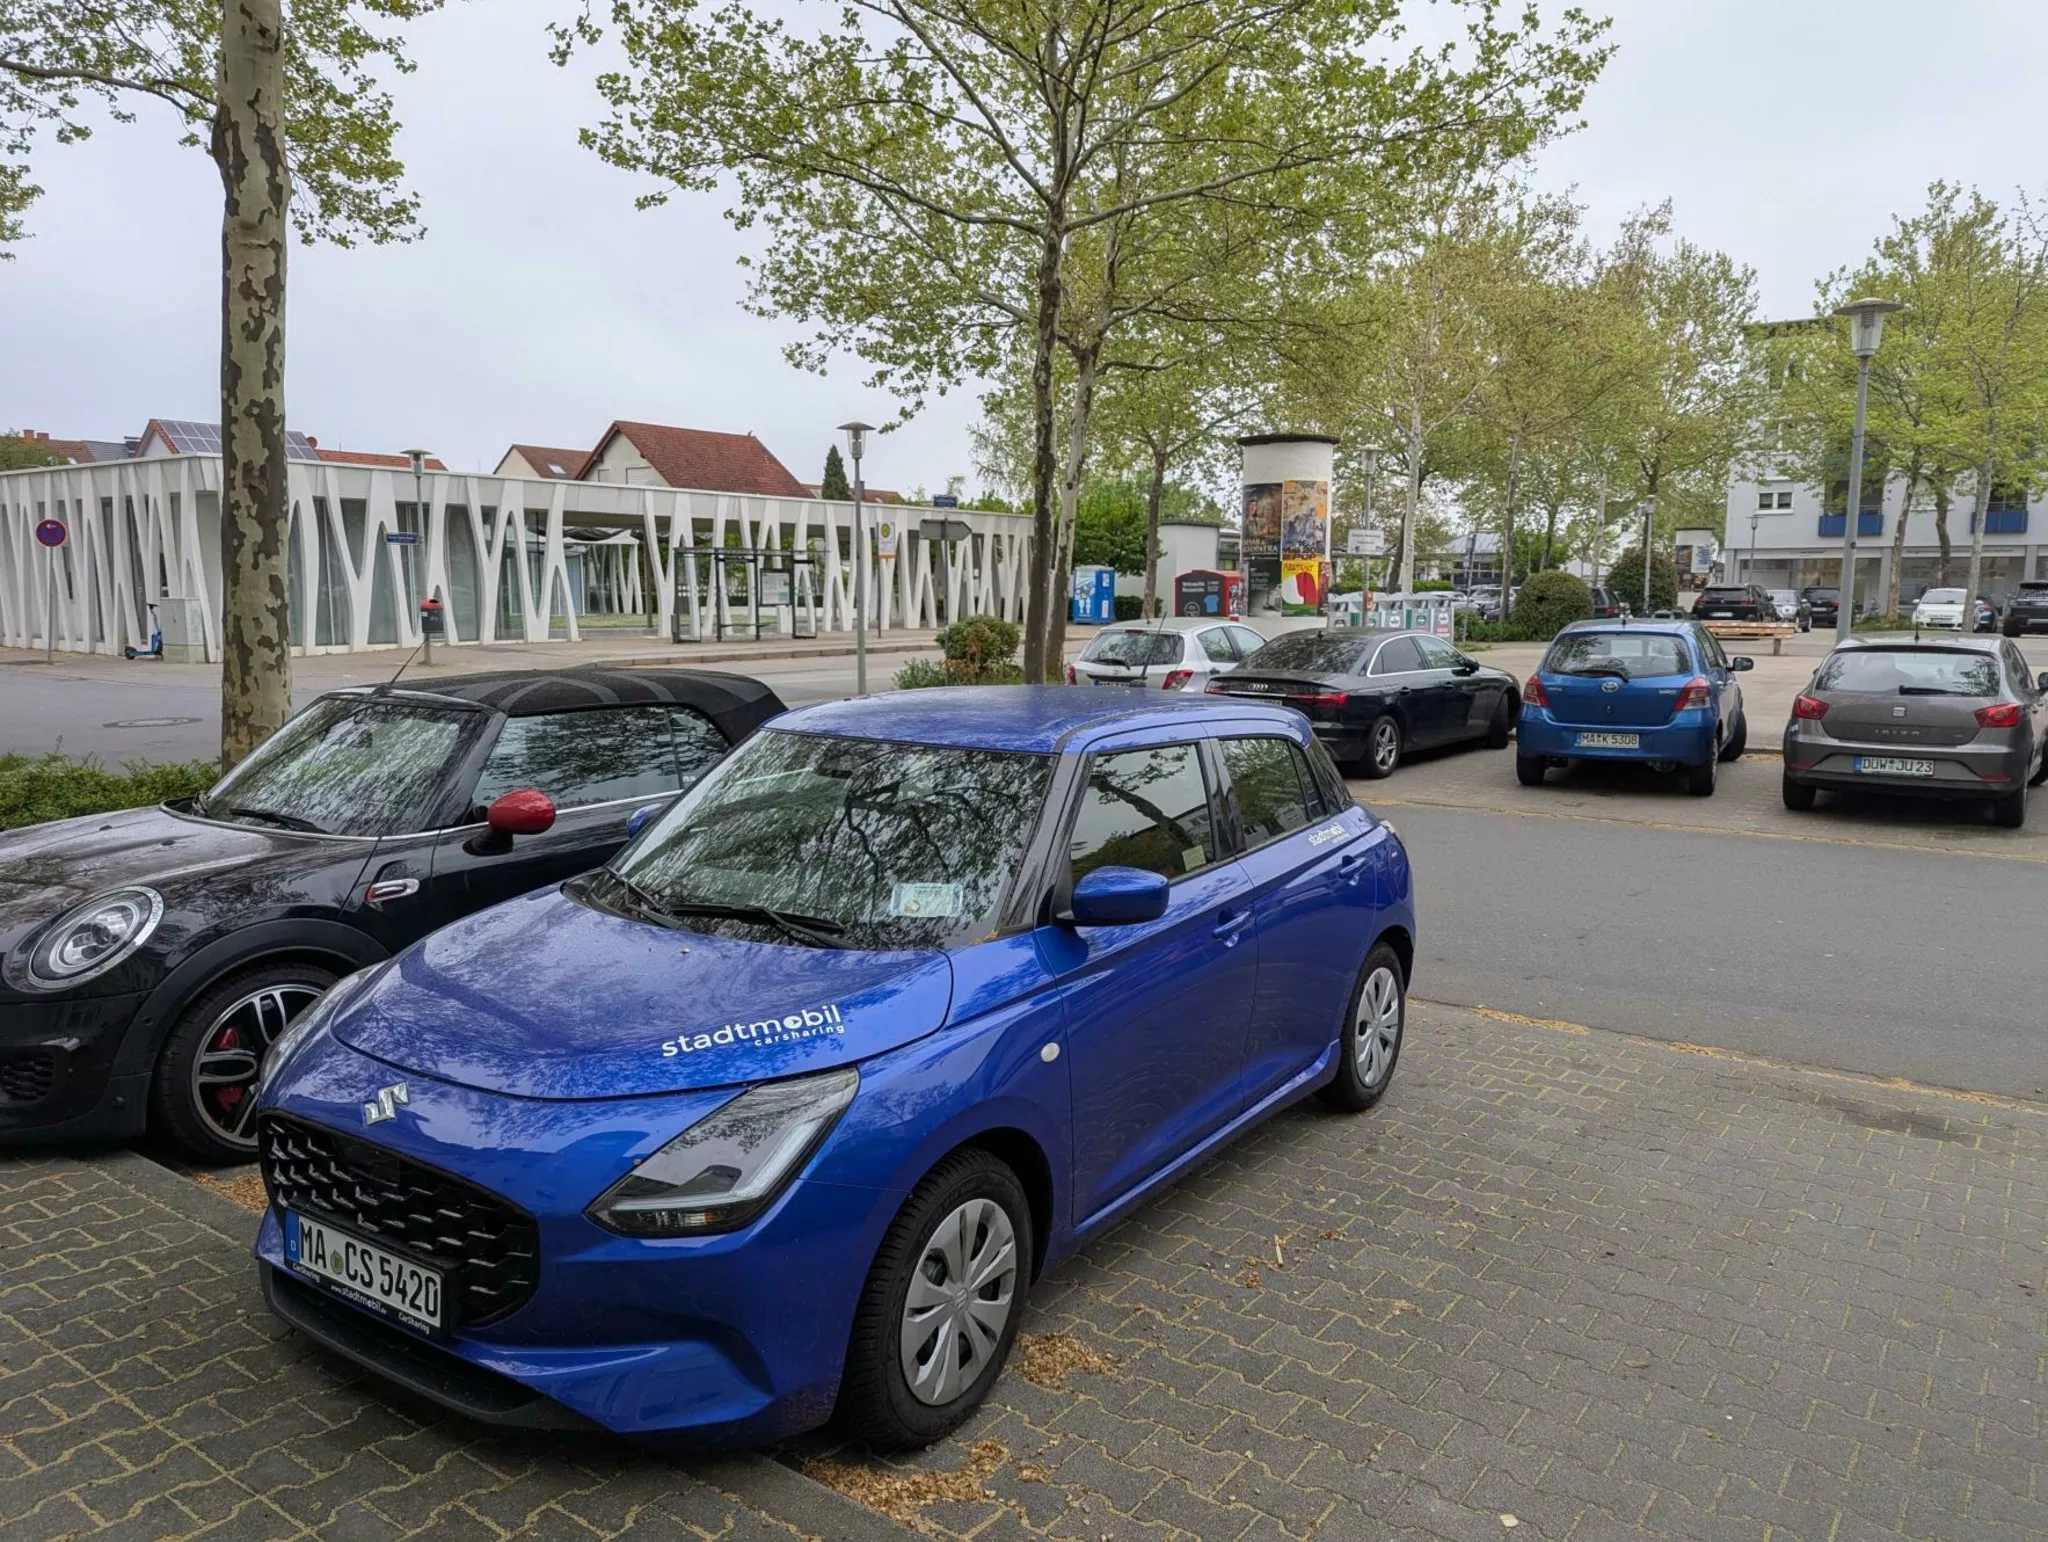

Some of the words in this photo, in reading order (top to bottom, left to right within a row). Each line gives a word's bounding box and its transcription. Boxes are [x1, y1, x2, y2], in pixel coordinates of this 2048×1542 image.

[1582, 734, 1596, 743] MA
[1602, 734, 1609, 744] K
[1611, 734, 1638, 745] 5308
[1916, 761, 1932, 773] 23
[662, 1004, 841, 1057] stadtmobil
[754, 1024, 845, 1047] carsharing
[290, 1240, 296, 1251] D
[300, 1221, 327, 1269] MA
[345, 1241, 374, 1289] CS
[379, 1255, 438, 1318] 5420
